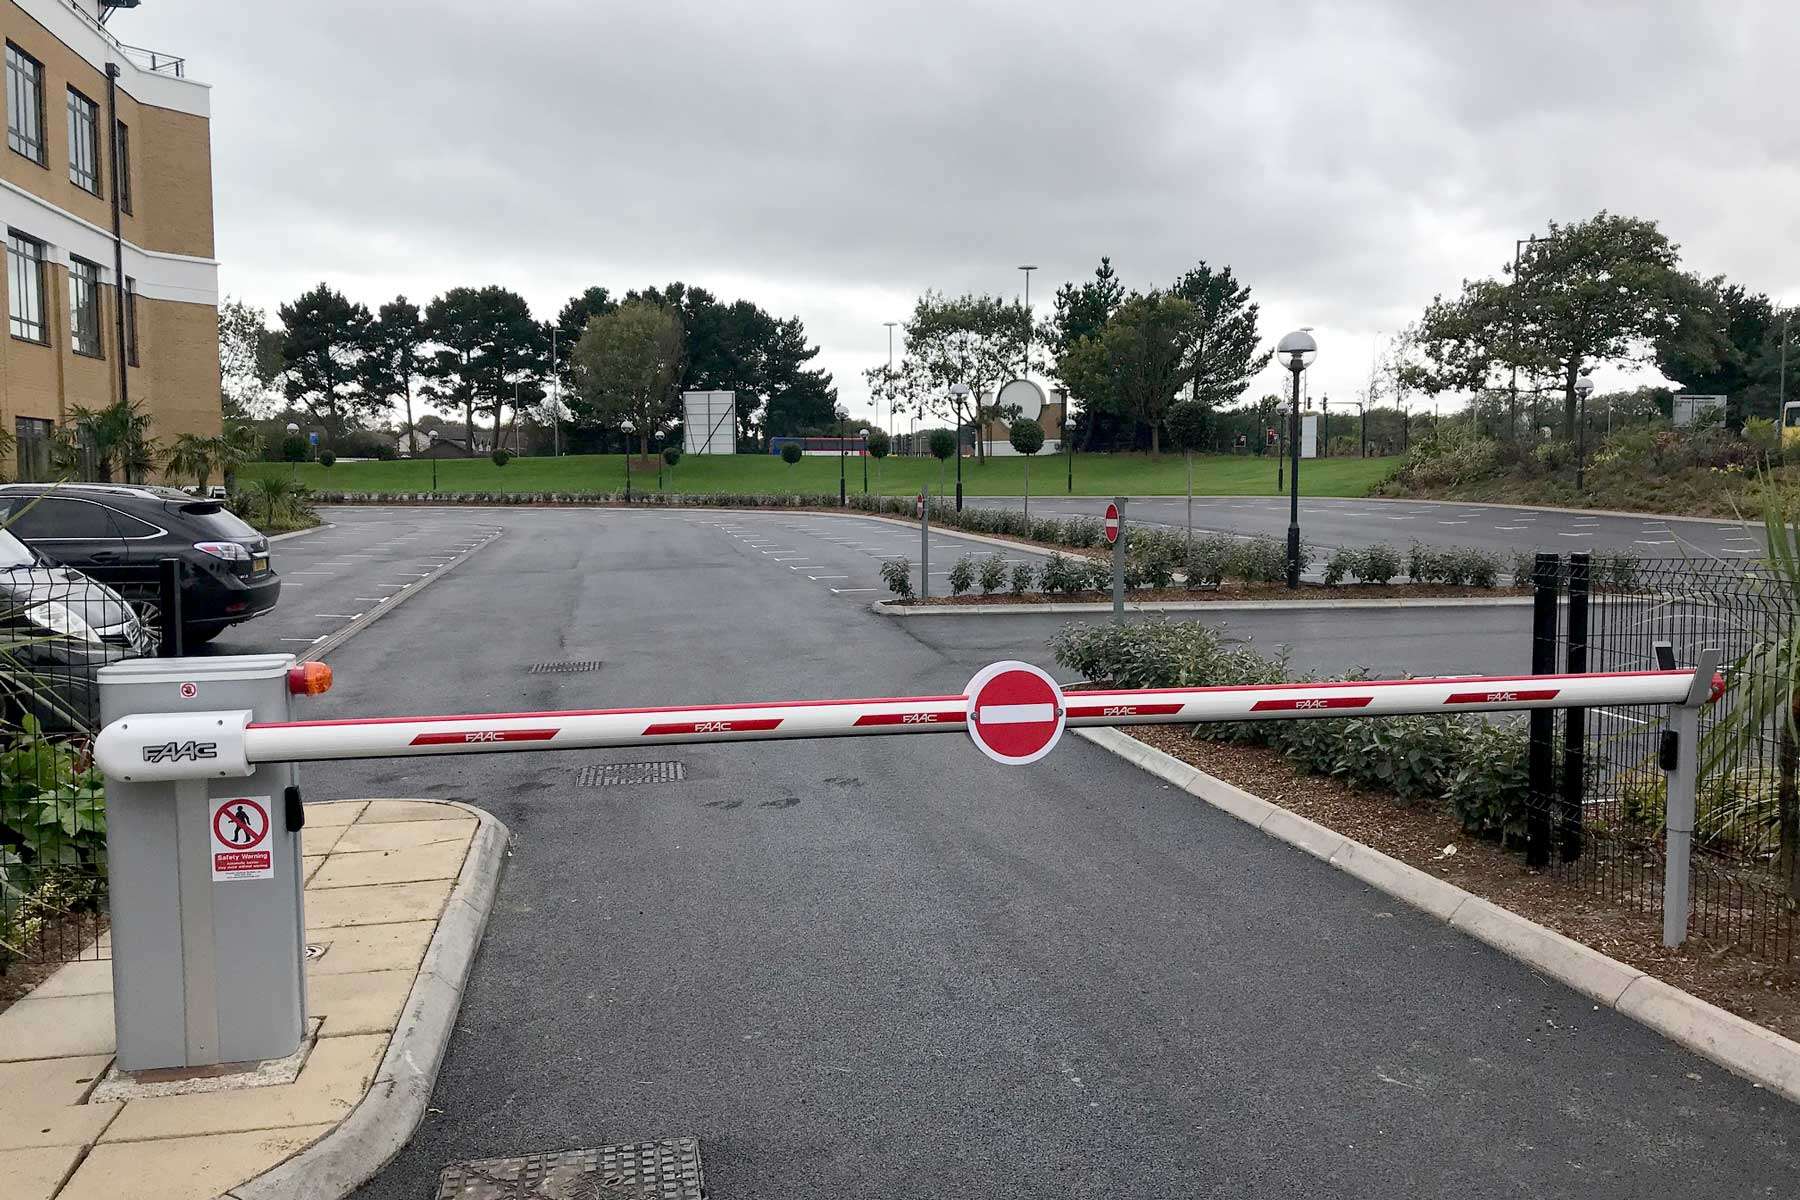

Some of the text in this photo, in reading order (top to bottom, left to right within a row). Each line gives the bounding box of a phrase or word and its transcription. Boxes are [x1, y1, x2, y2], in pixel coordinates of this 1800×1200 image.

[1487, 692, 1518, 702] FAAC
[1295, 699, 1328, 709] FAAC
[1103, 706, 1137, 716] FAAC
[902, 713, 938, 723] FAAC
[694, 722, 732, 732] FAAC
[465, 731, 505, 742] FAAC
[142, 741, 217, 763] FAAC
